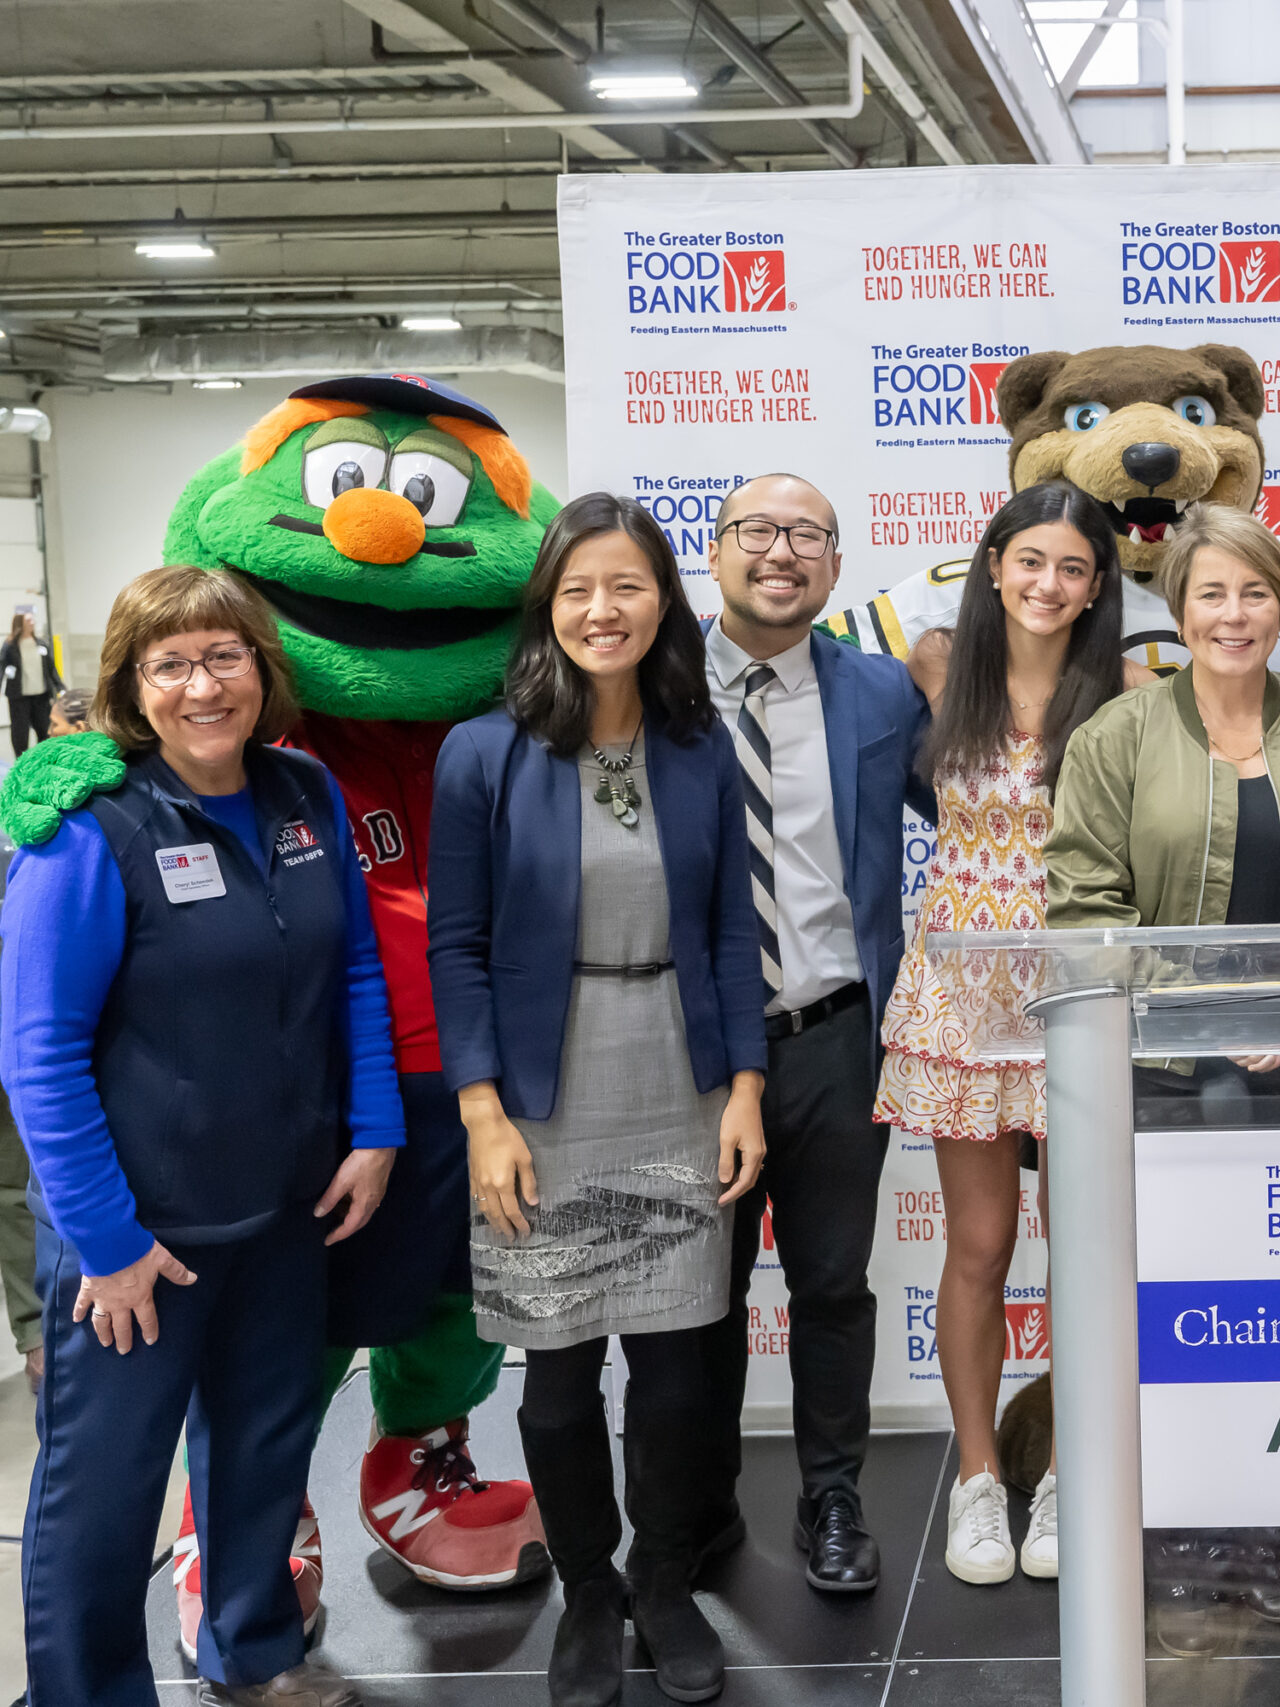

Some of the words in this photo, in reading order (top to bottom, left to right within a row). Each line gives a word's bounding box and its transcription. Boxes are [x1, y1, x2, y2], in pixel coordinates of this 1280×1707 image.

[624, 232, 655, 246] The
[659, 232, 721, 246] Greater
[726, 232, 784, 245] Boston
[1121, 222, 1151, 237] The
[1155, 223, 1218, 236] Greater
[1222, 222, 1280, 236] Boston
[628, 252, 719, 280] FOOD
[862, 245, 966, 272] TOGETHER,
[974, 244, 1002, 268] WE
[1009, 243, 1046, 268] CAN
[1122, 242, 1215, 271] FOOD
[629, 286, 720, 313] BANK
[865, 276, 902, 301] END
[911, 274, 990, 299] HUNGER
[999, 273, 1054, 297] HERE.
[1123, 276, 1214, 304] BANK
[630, 326, 669, 336] Feeding
[672, 326, 710, 334] Eastern
[1124, 318, 1163, 326] Feeding
[1165, 317, 1204, 325] Eastern
[872, 345, 902, 360] The
[906, 345, 967, 359] Greater
[972, 344, 1030, 357] Boston
[624, 371, 728, 398] TOGETHER,
[736, 370, 764, 393] WE
[772, 369, 808, 393] CAN
[874, 364, 965, 392] FOOD
[627, 400, 665, 424] END
[674, 398, 753, 423] HUNGER
[762, 398, 816, 422] HERE.
[875, 398, 965, 426] BANK
[876, 440, 914, 448] Feeding
[917, 438, 955, 446] Eastern
[633, 476, 664, 490] The
[667, 476, 728, 490] Greater
[869, 492, 972, 518] TOGETHER,
[872, 522, 908, 545] END
[918, 520, 988, 544] HUNGE
[680, 568, 710, 576] Easter
[284, 856, 304, 867] TEAM
[897, 1219, 934, 1241] END
[904, 1286, 934, 1300] The
[1004, 1286, 1046, 1298] Bosto
